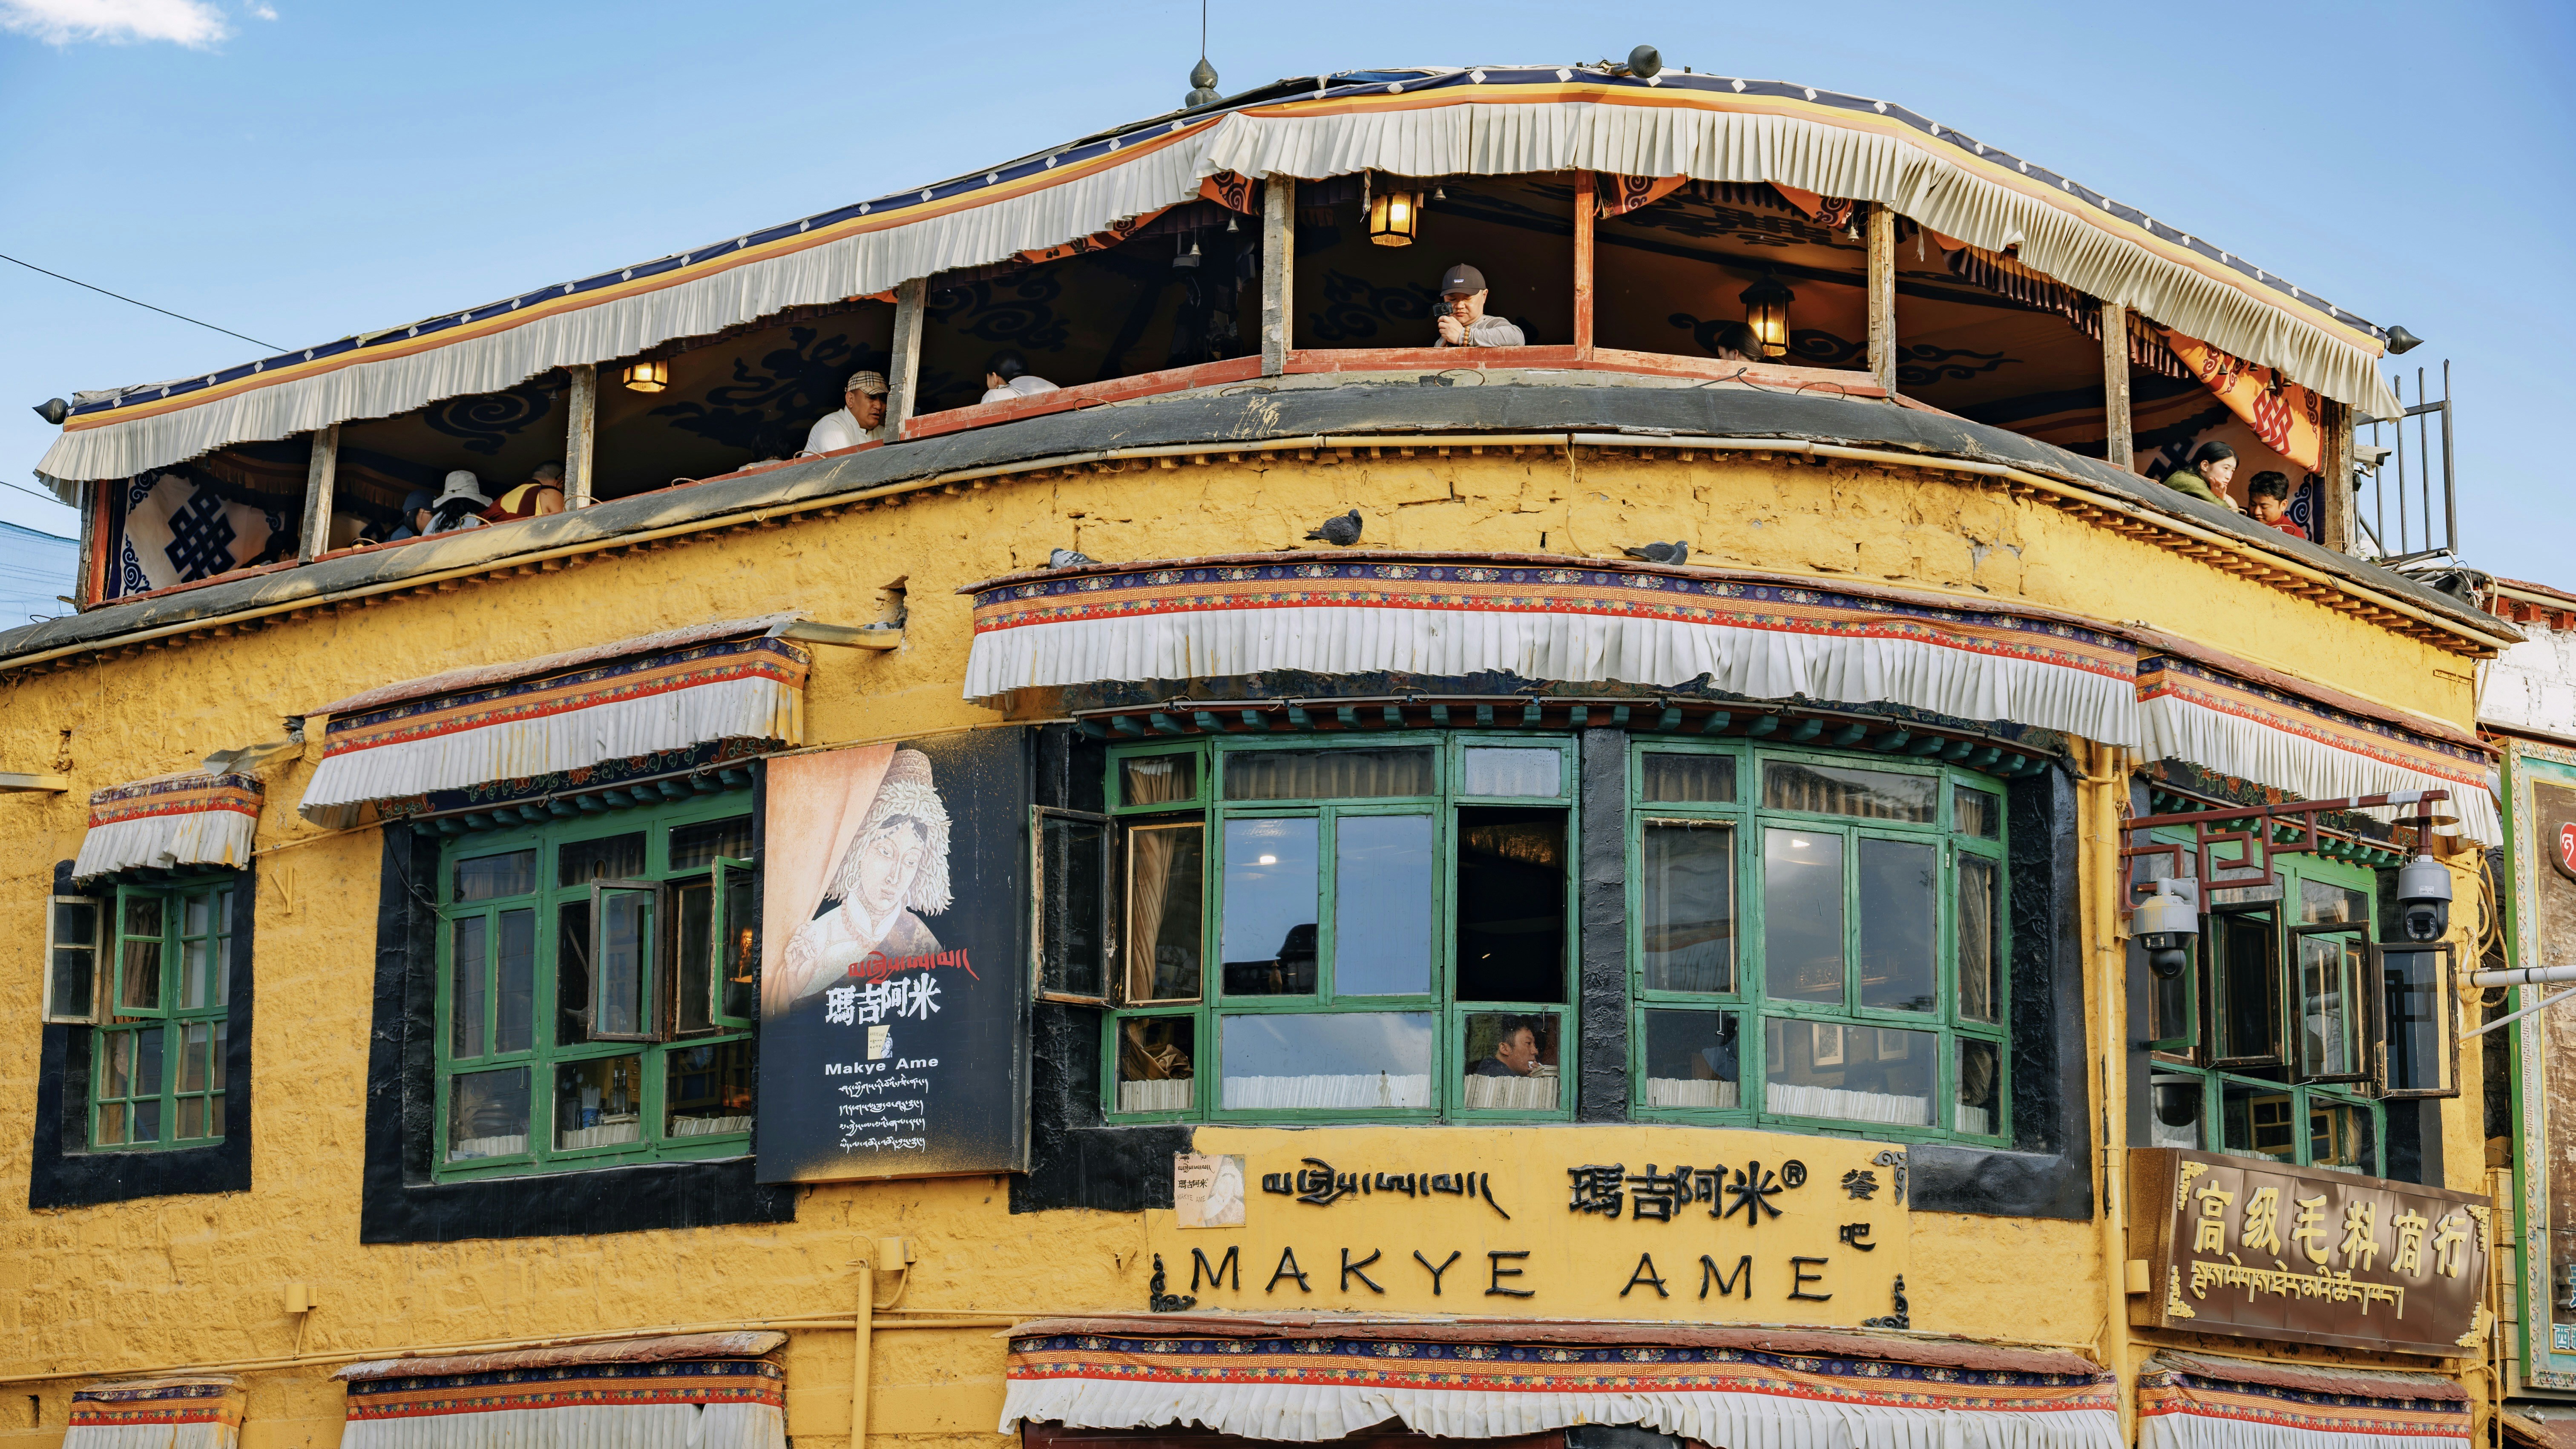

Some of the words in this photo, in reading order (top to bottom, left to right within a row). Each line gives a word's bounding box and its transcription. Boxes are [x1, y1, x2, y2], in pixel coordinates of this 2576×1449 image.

[825, 973, 941, 1026] 瑪吉阿米
[825, 1062, 886, 1075] Makye
[895, 1058, 939, 1070] Ame
[2194, 1180, 2467, 1278] 高级毛料商行
[1190, 1246, 1535, 1298] MAKYE
[1620, 1252, 1832, 1301] AME
[2553, 1323, 2576, 1350] 西
